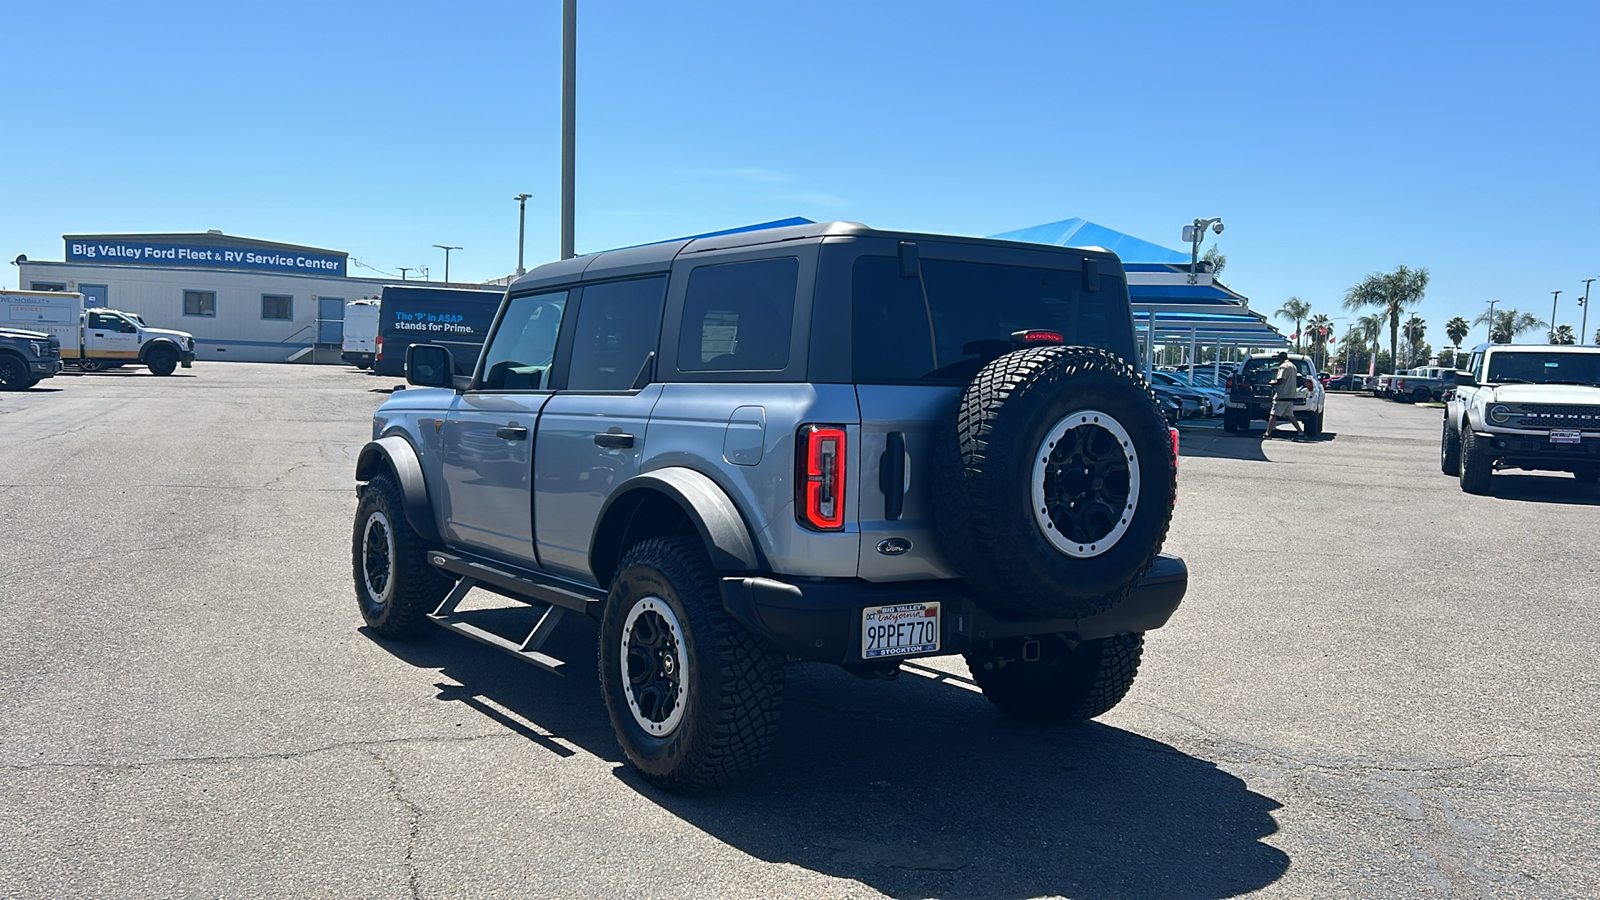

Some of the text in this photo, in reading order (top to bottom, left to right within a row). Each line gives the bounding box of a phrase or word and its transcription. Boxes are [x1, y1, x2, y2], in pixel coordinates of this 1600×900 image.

[73, 244, 338, 269] Big Valley Ford Fleet & RV Service Center
[396, 312, 413, 320] The
[428, 313, 437, 321] in
[438, 314, 463, 323] ASAP
[395, 321, 474, 333] stands for Prime.
[879, 612, 922, 623] California
[868, 621, 934, 649] 9PPF770
[881, 646, 922, 655] STOCKTON
